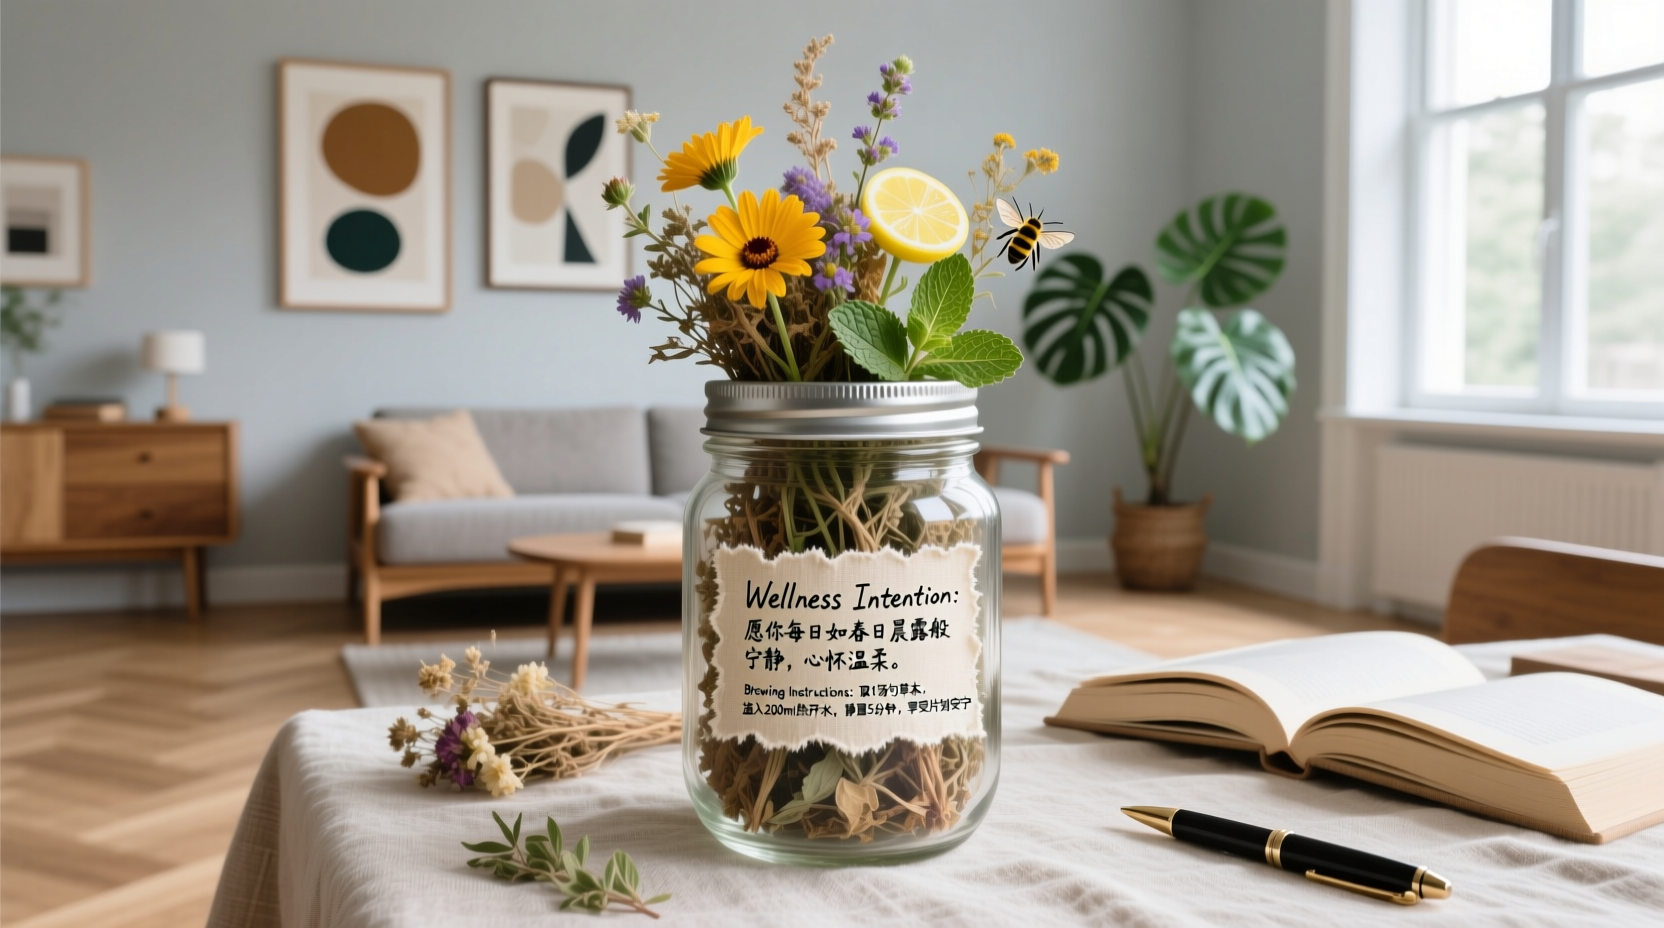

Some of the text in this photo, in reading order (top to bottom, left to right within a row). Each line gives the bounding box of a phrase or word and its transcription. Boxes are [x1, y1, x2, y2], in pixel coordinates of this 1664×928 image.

[746, 579, 959, 611] Wellness Intention:
[744, 617, 951, 642] 愿你每日如春日晨露般
[744, 646, 899, 672] 宁静，心怀温柔。
[744, 683, 785, 700] Brewing
